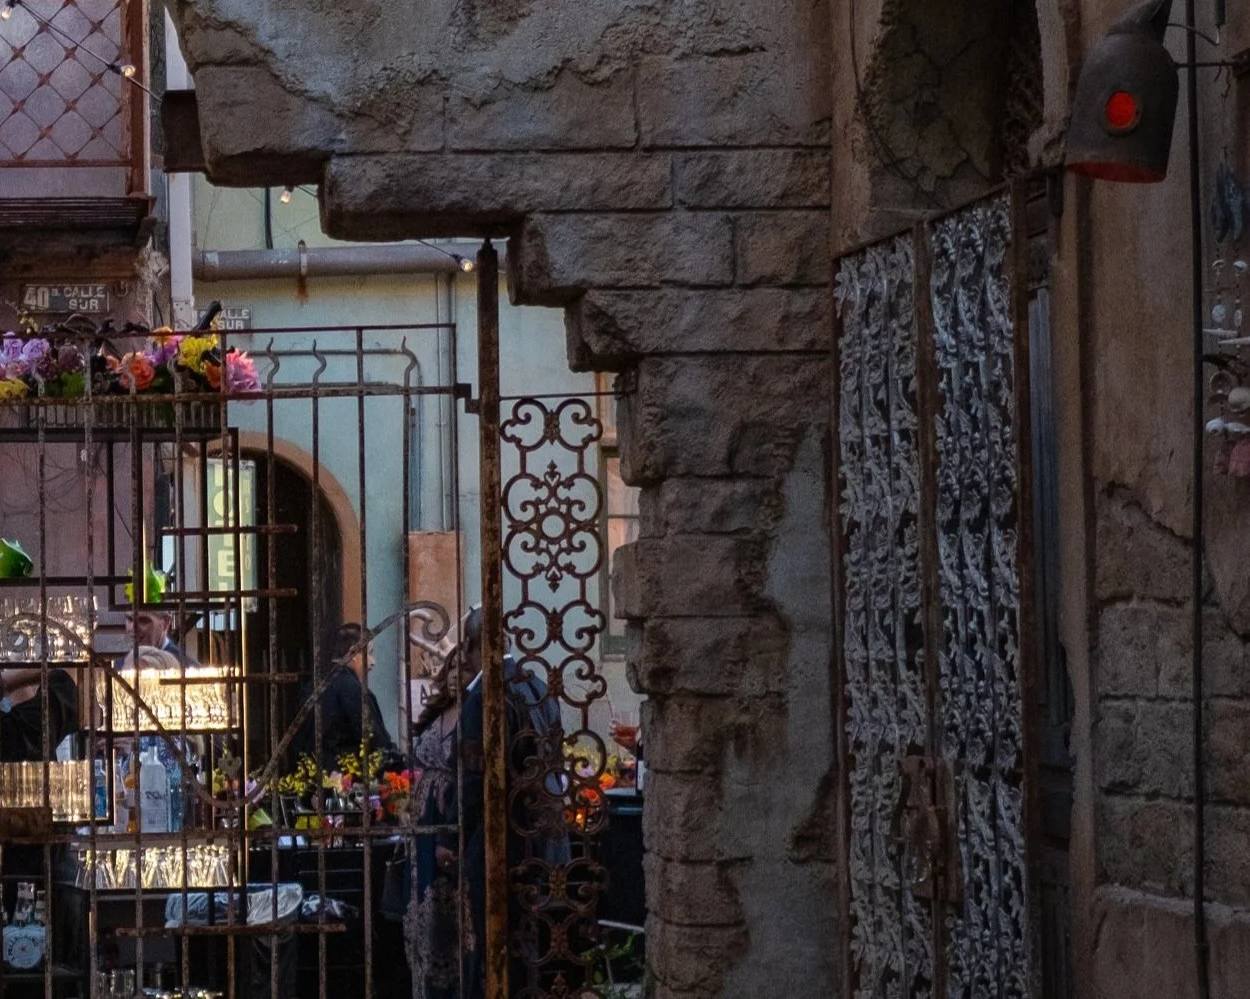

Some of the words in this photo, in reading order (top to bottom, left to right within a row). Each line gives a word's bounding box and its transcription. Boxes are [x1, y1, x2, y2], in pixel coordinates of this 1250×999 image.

[63, 286, 106, 298] CALLE
[69, 299, 99, 310] SUR
[217, 308, 250, 319] ALLE
